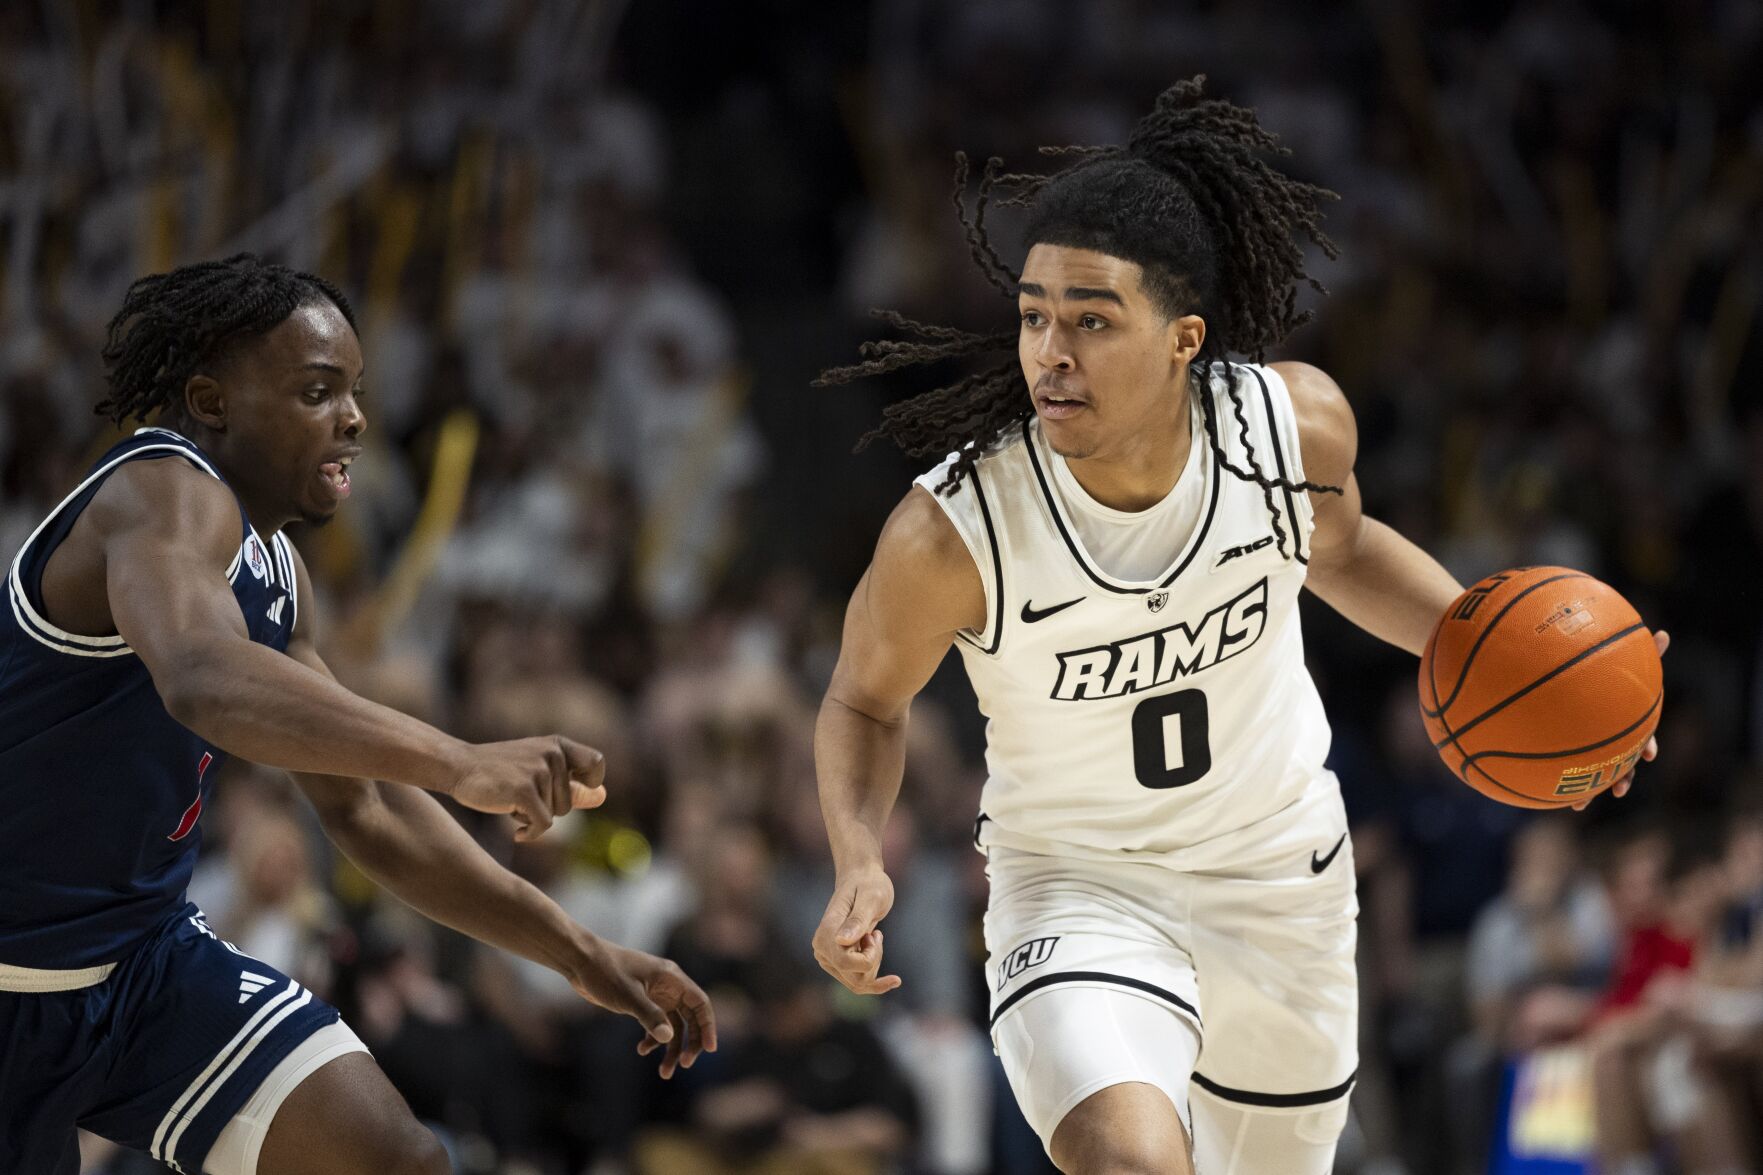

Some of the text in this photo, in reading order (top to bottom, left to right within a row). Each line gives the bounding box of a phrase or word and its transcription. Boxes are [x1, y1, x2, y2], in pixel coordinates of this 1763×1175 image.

[1050, 576, 1268, 701] RAMS
[1131, 688, 1212, 789] 0
[997, 936, 1061, 993] VCU
